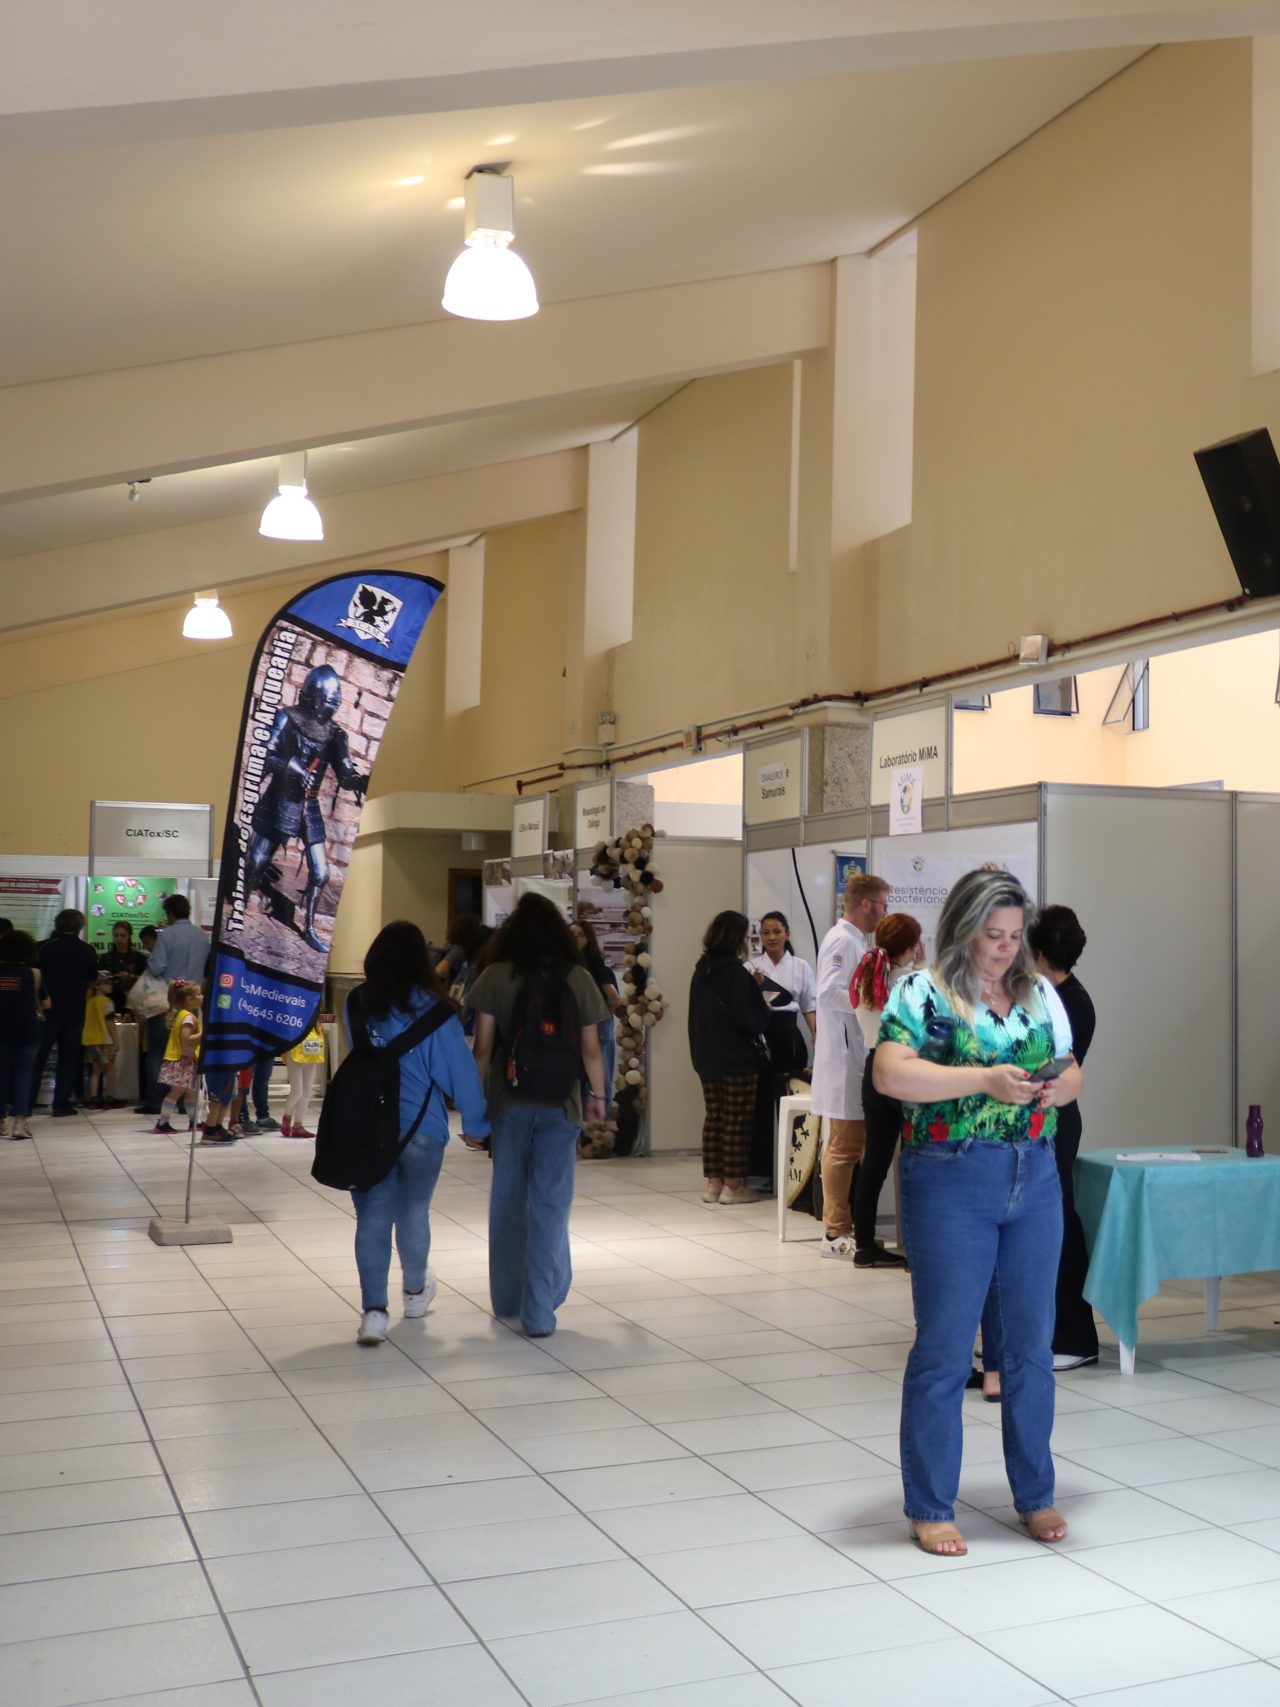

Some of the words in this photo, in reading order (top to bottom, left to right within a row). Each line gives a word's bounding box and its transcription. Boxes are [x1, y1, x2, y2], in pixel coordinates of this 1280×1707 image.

[253, 629, 298, 726] Arquearia
[253, 727, 271, 743] e
[880, 749, 917, 769] Laboratório
[918, 745, 938, 761] MiMA
[239, 743, 268, 826] Esgrima
[761, 785, 785, 800] Samurais
[126, 828, 179, 839] CIATox/SC
[226, 856, 246, 932] Treinos
[889, 885, 948, 895] Resistência
[275, 1014, 303, 1028] 6206
